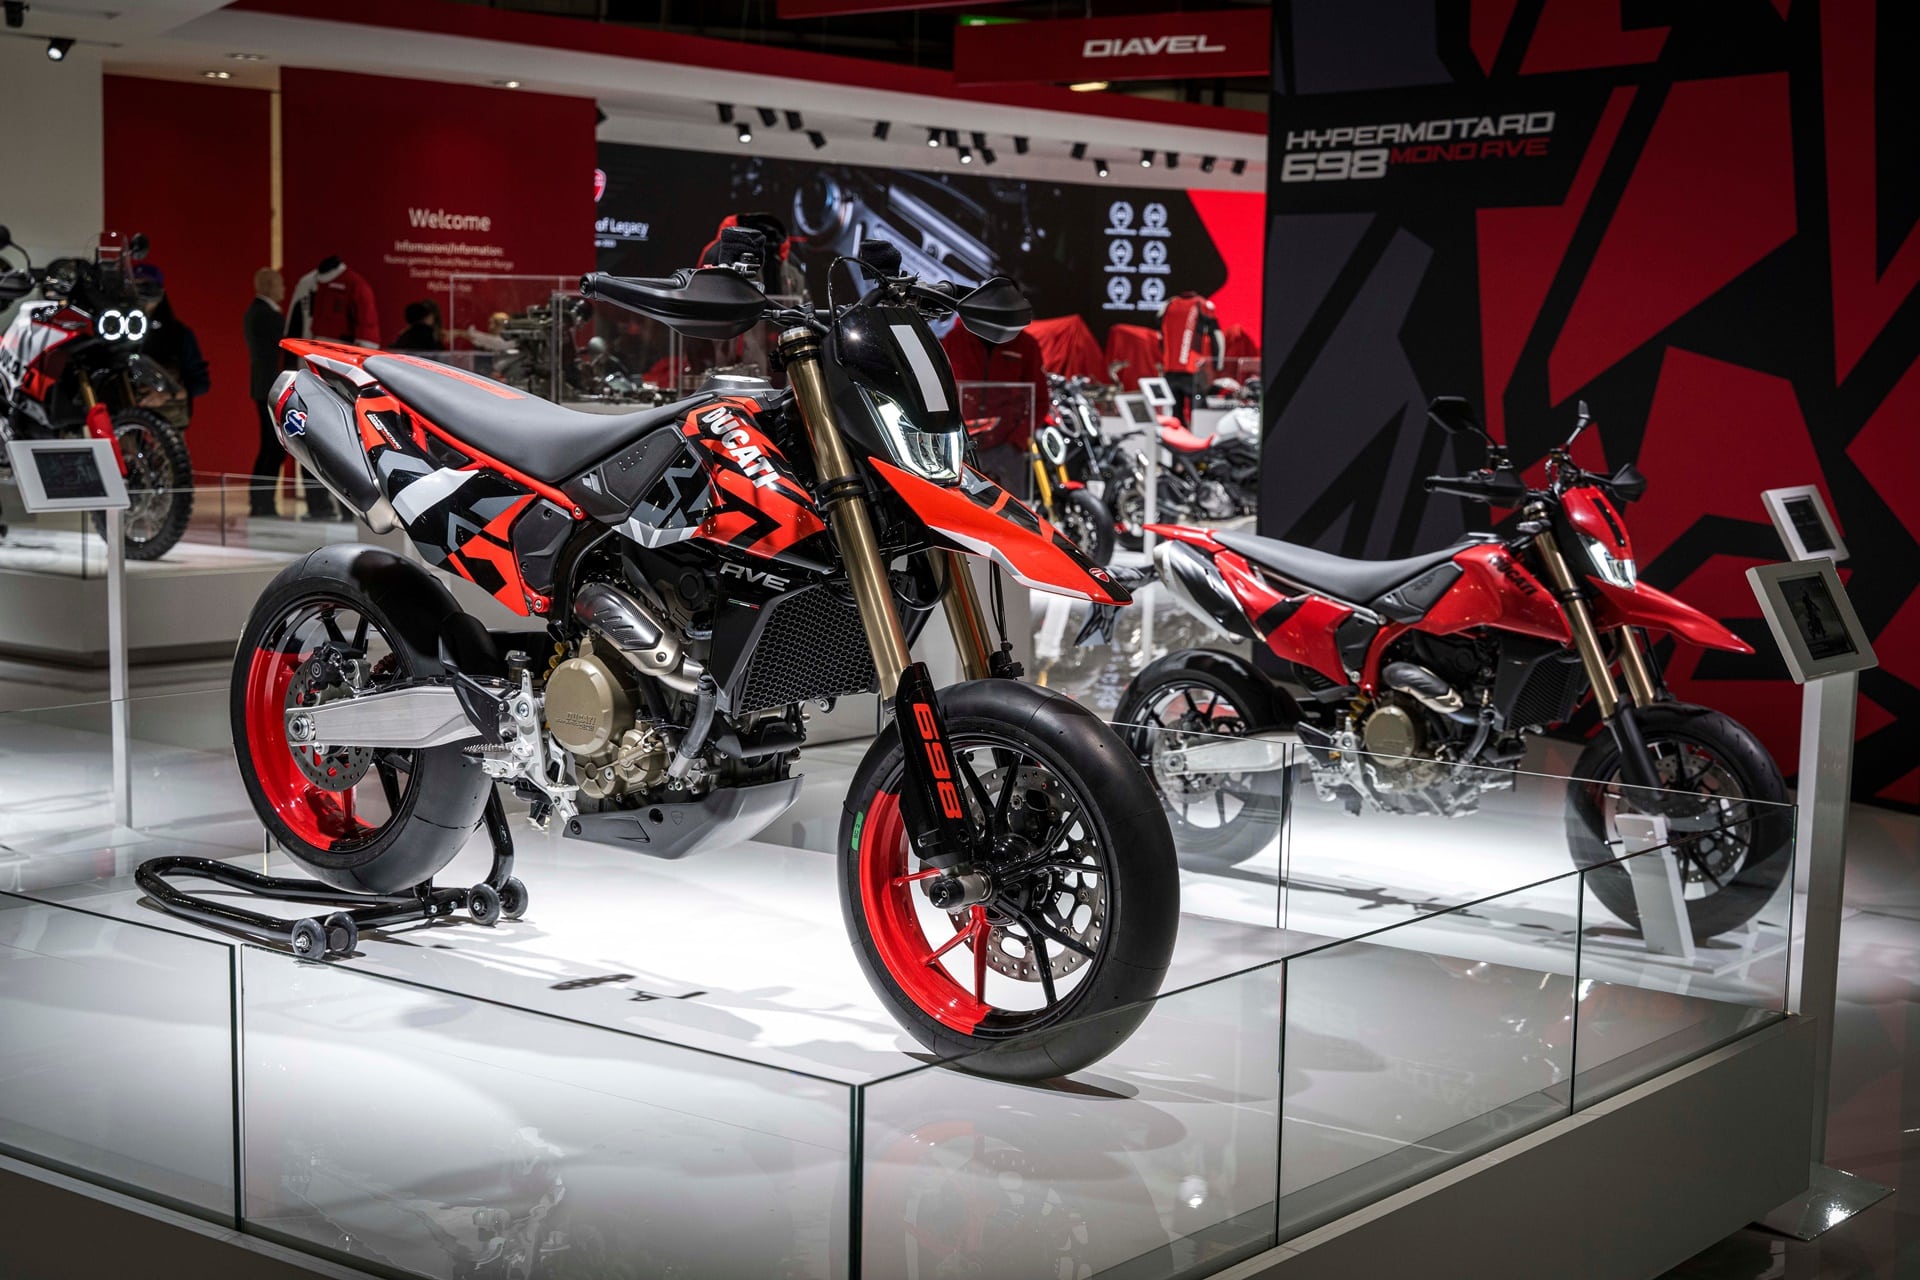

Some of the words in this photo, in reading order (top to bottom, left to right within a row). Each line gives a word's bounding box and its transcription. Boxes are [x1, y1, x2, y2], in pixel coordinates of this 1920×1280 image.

[1082, 34, 1226, 58] DIAVEL
[1286, 111, 1555, 150] HYPERMOTARD
[1280, 148, 1389, 182] 698
[1389, 142, 1477, 165] MONO
[408, 207, 492, 232] Welcome
[595, 217, 609, 232] of
[609, 218, 649, 238] Legacy
[702, 406, 780, 488] DUCATI
[912, 703, 963, 819] 698
